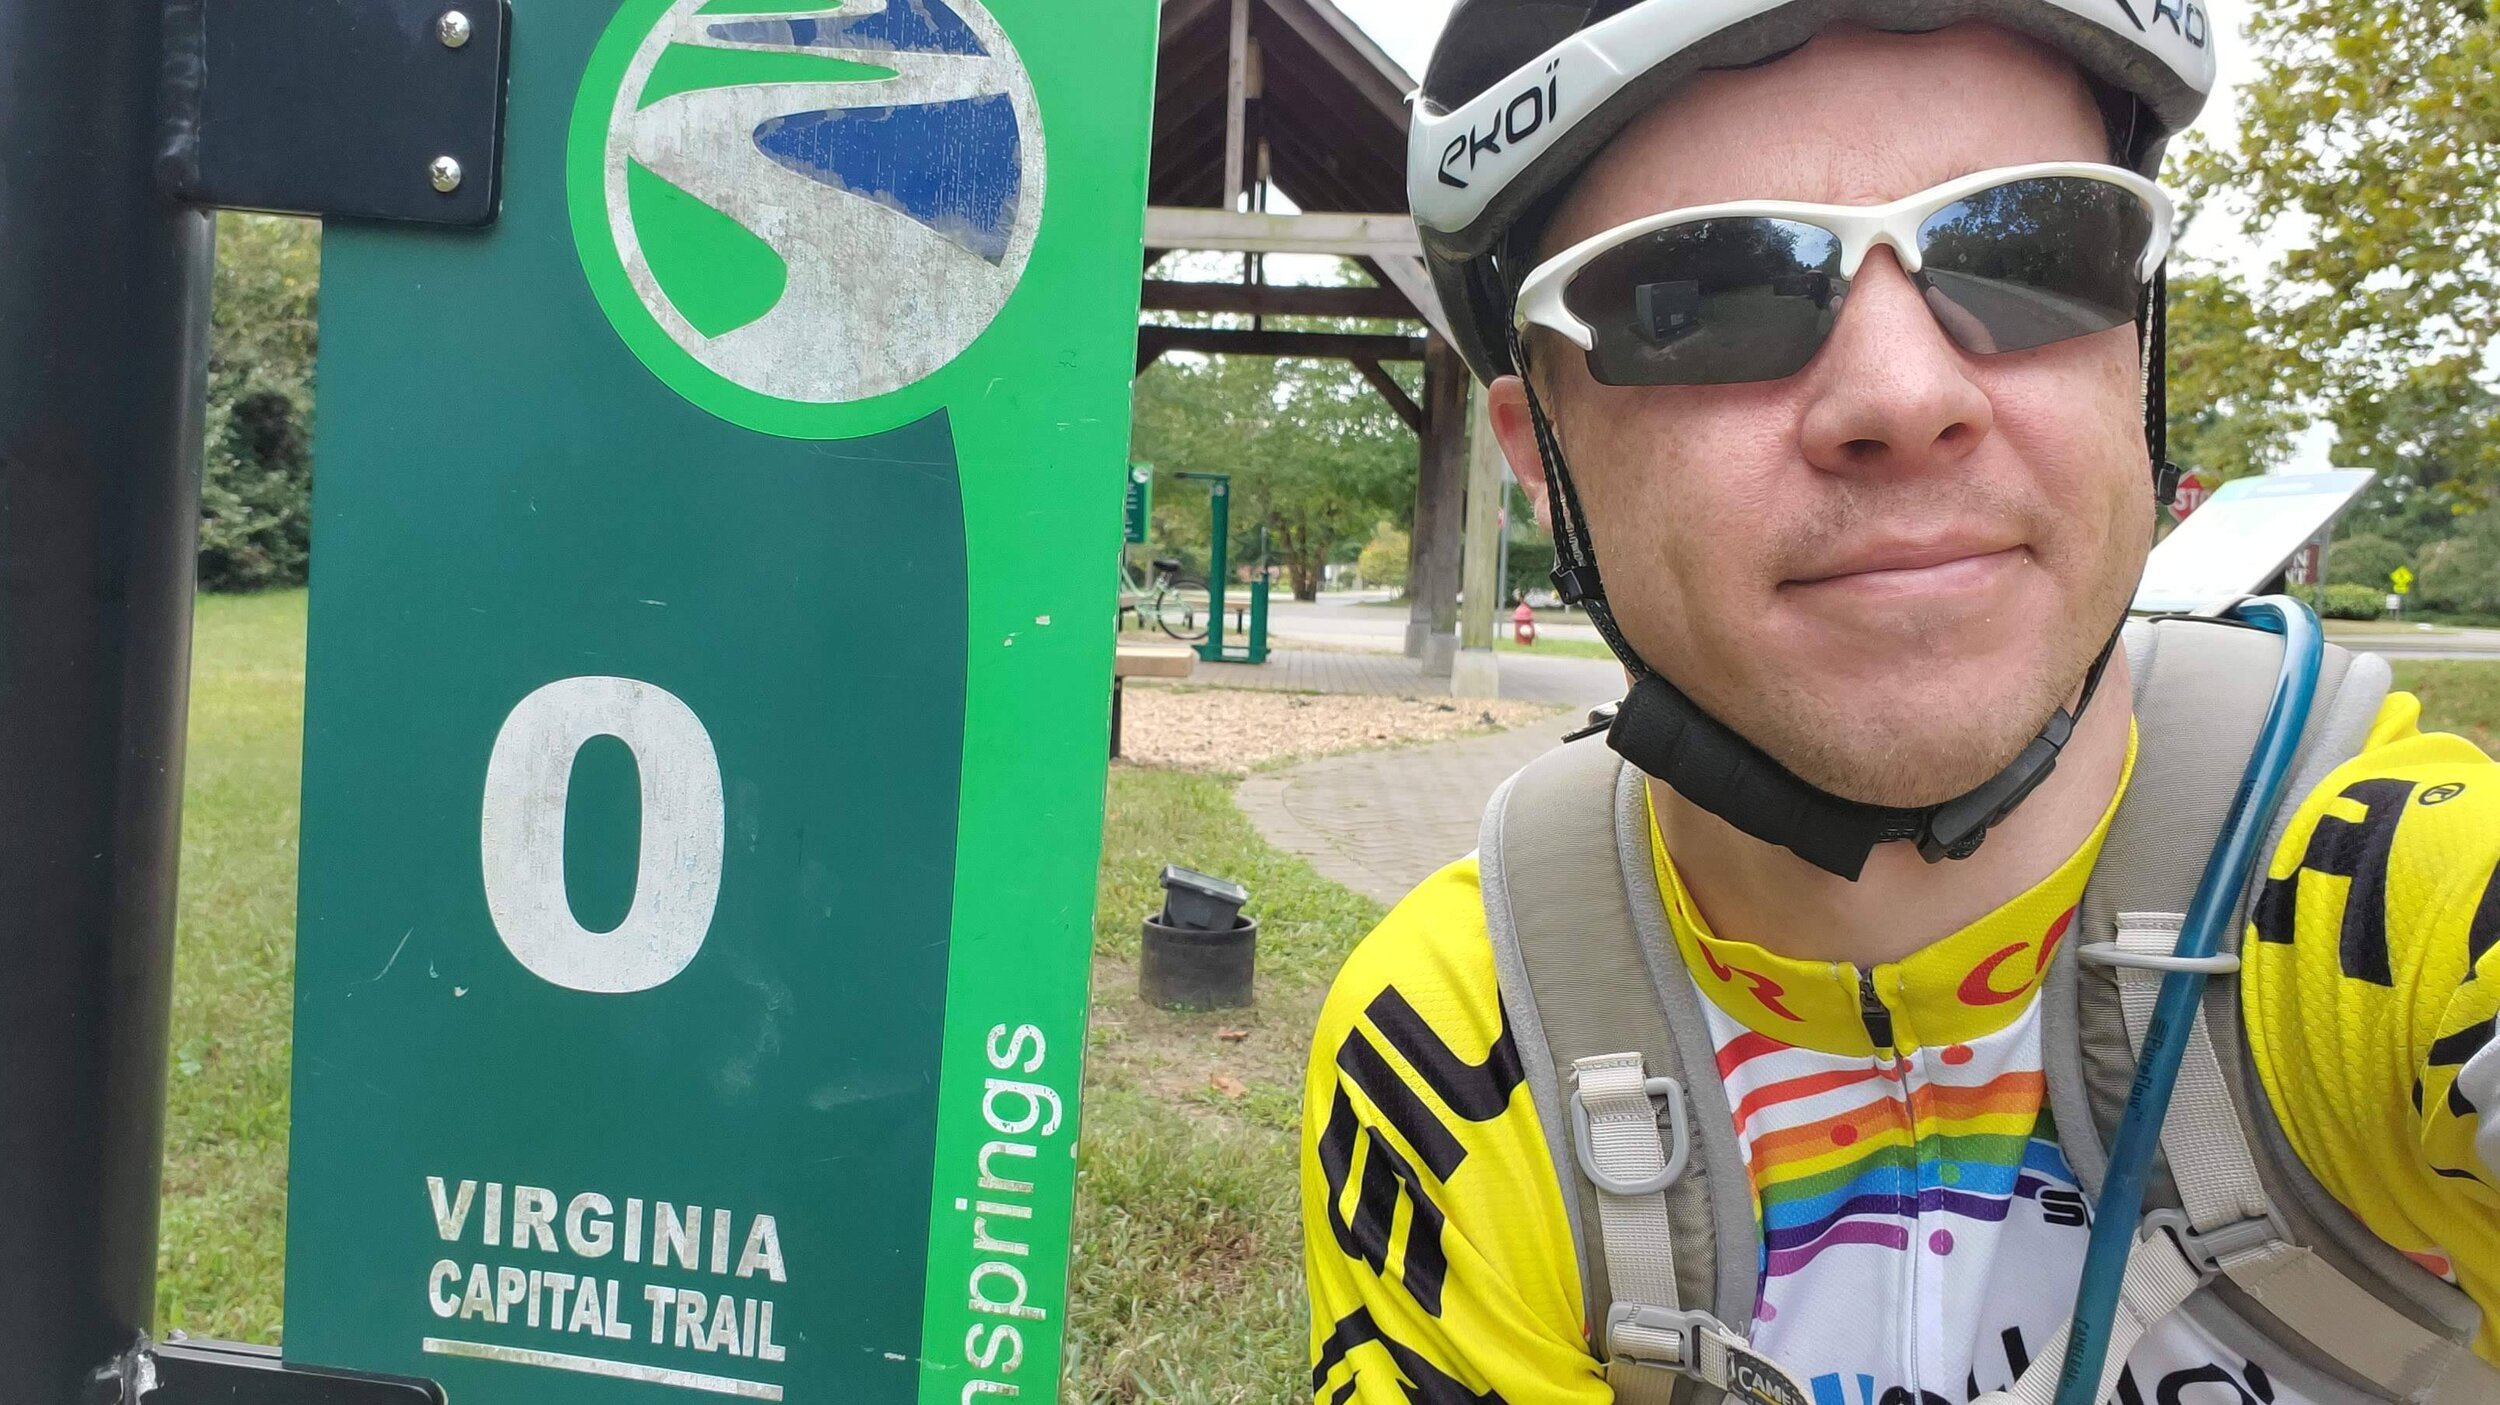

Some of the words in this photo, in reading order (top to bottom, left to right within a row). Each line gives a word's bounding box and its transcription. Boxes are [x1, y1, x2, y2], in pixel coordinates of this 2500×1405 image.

[481, 675, 725, 993] 0
[425, 1175, 788, 1283] VIRGINIA
[428, 1258, 632, 1340] CAPITAL
[644, 1283, 787, 1363] TRAIL
